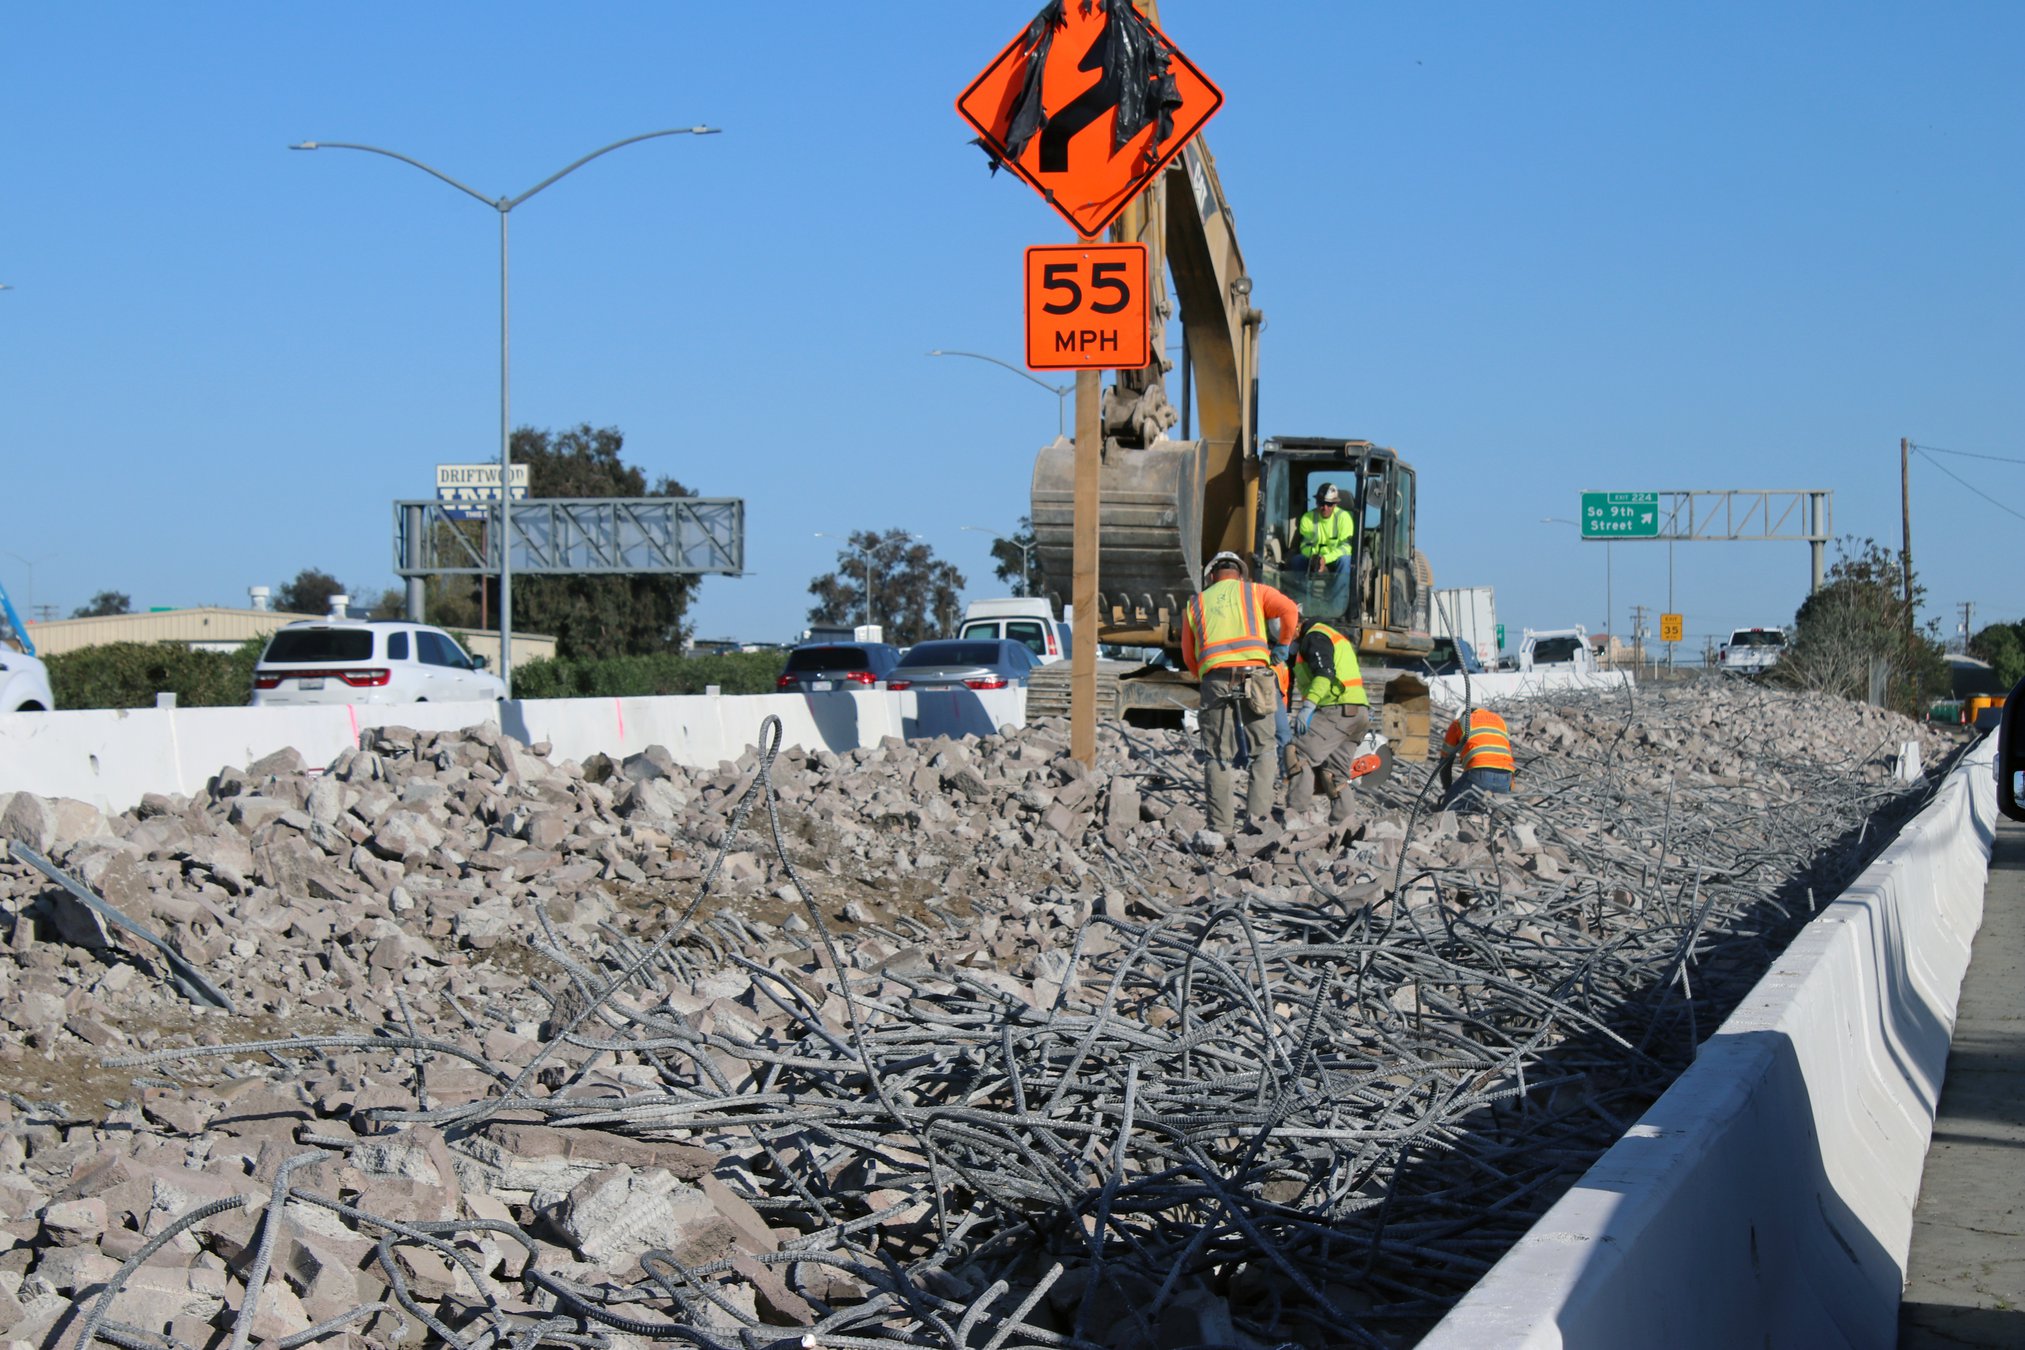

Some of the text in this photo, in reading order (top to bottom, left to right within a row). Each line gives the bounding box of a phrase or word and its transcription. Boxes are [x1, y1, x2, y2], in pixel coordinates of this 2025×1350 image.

[1042, 262, 1130, 315] 55
[1055, 329, 1118, 352] MPH
[1632, 493, 1652, 502] 224
[1587, 506, 1634, 517] So 9th
[1591, 520, 1632, 530] Street
[1664, 626, 1679, 635] 35
